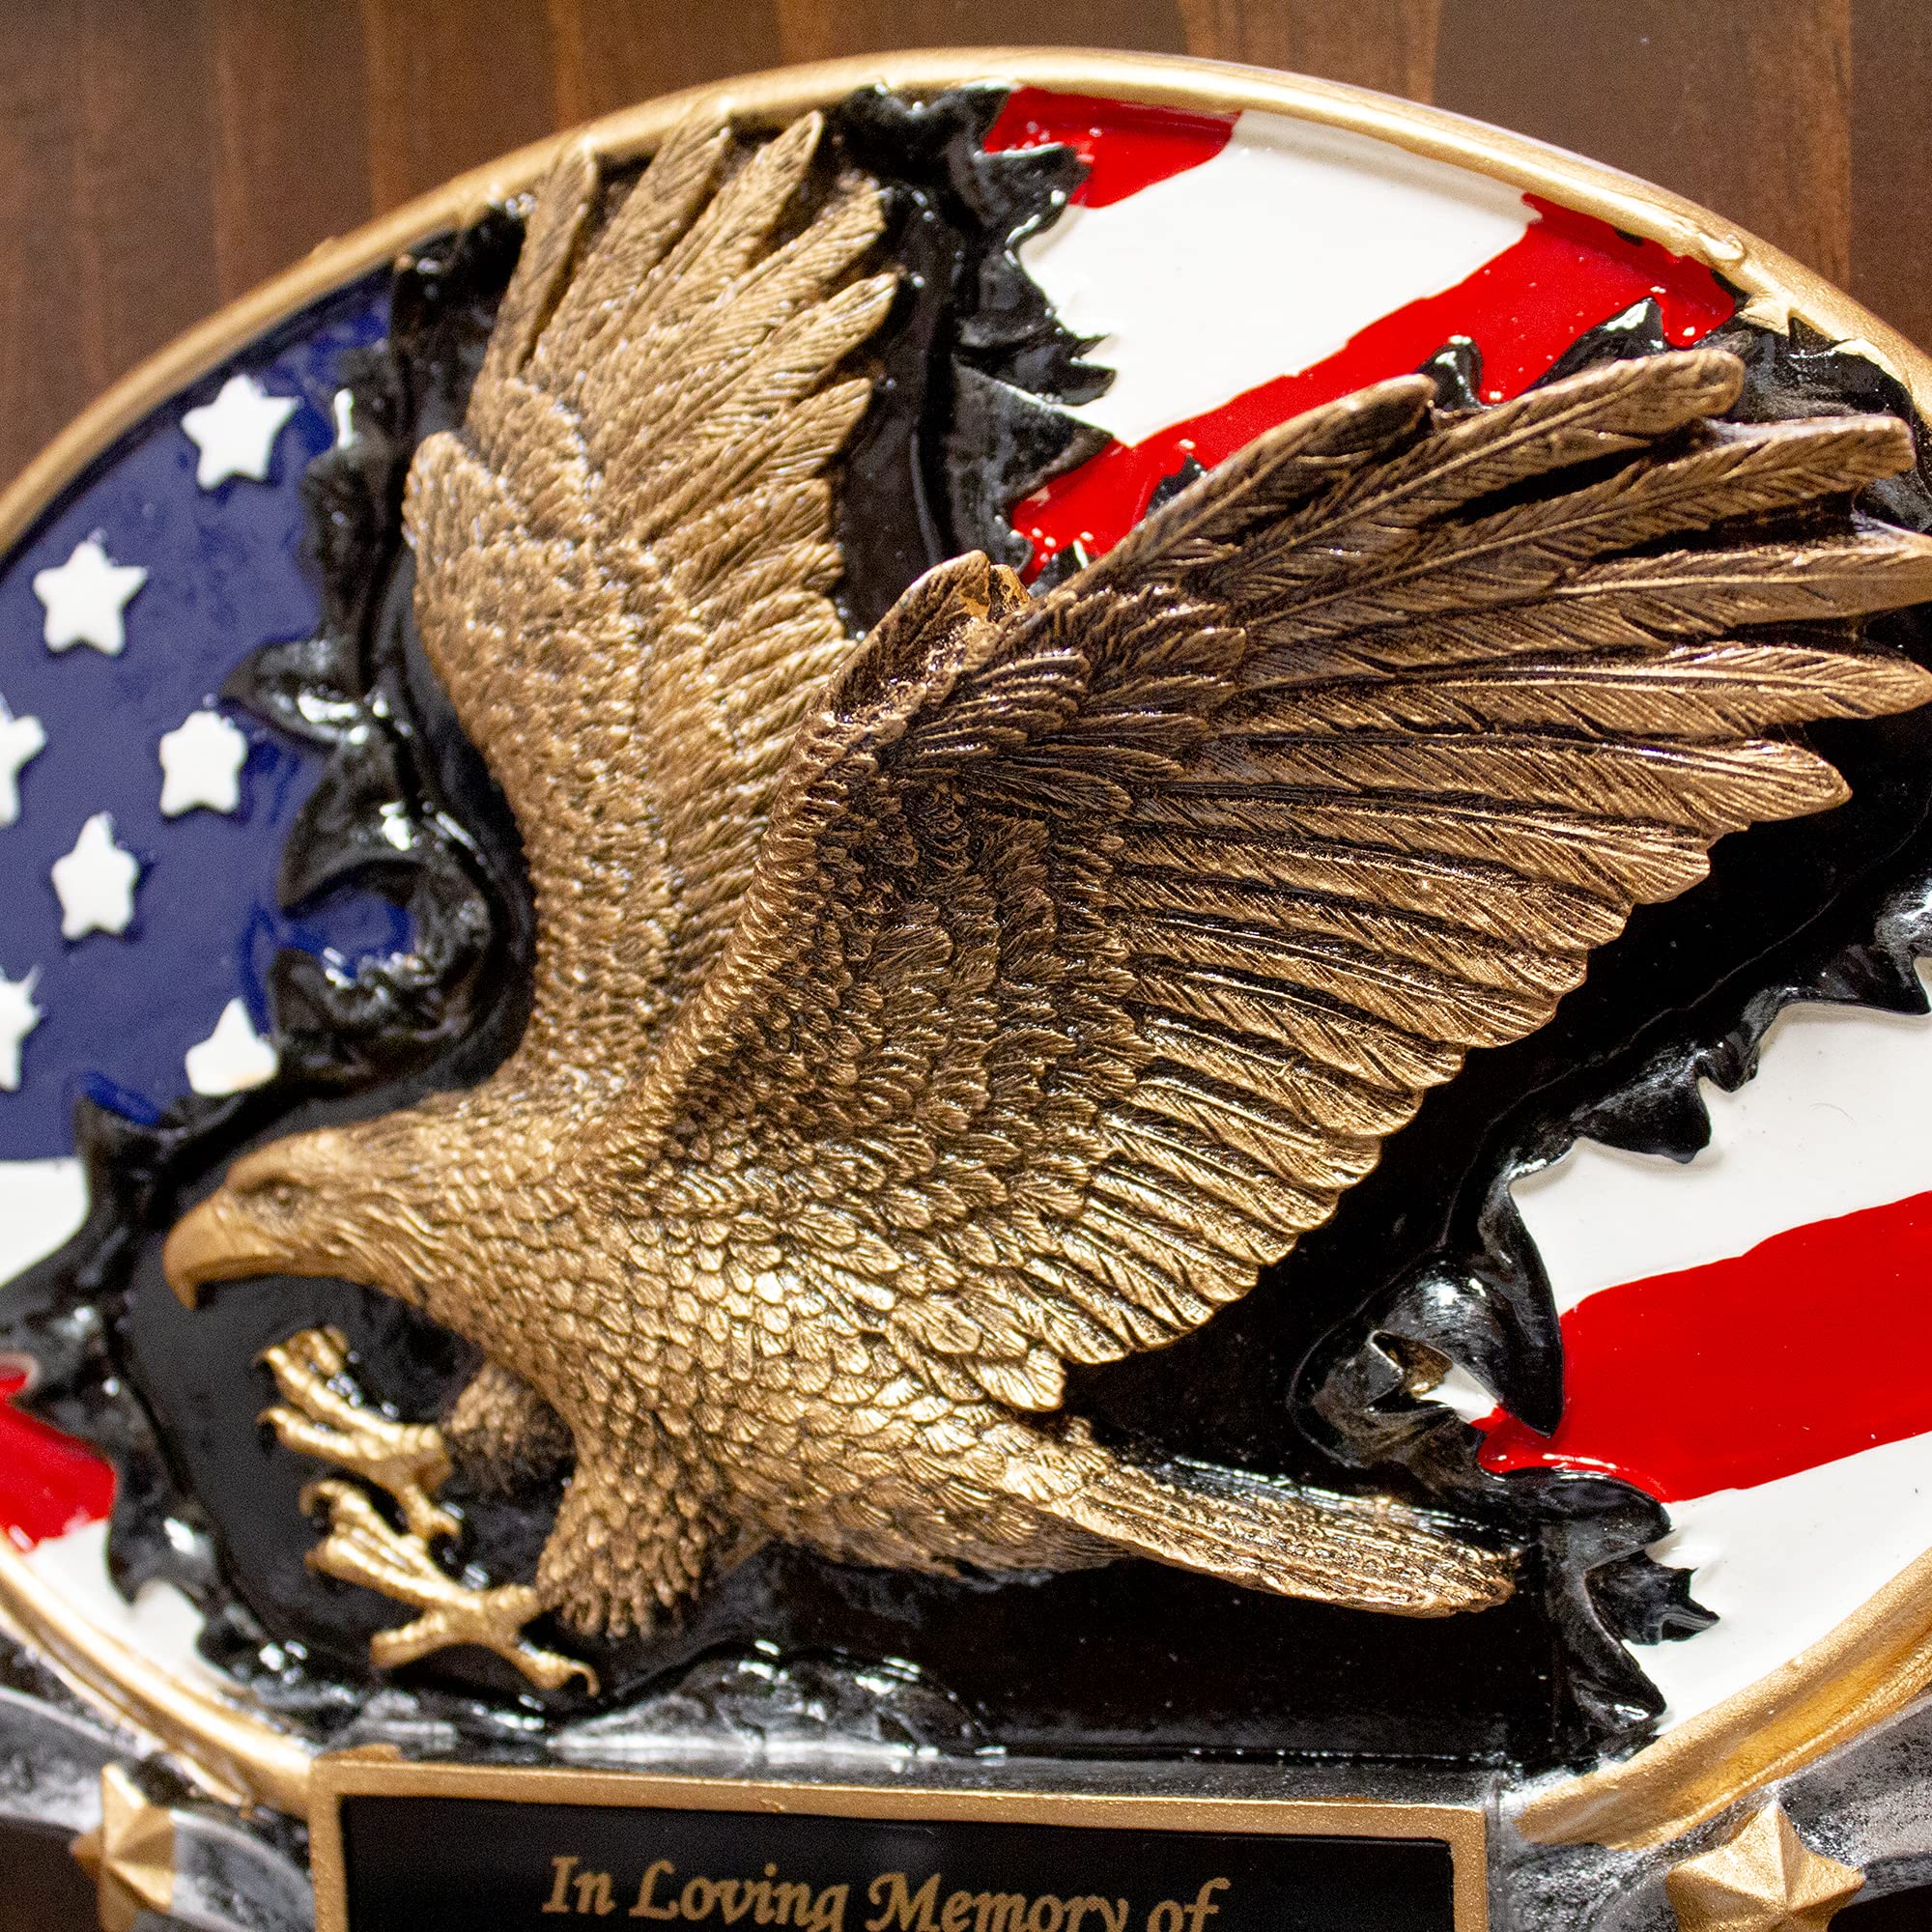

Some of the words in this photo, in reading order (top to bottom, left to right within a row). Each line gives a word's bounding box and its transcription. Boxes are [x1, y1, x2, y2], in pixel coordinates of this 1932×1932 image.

[542, 1856, 615, 1916] In
[629, 1860, 850, 1932] Loving
[866, 1872, 1128, 1932] Memory
[1147, 1878, 1231, 1932] of
